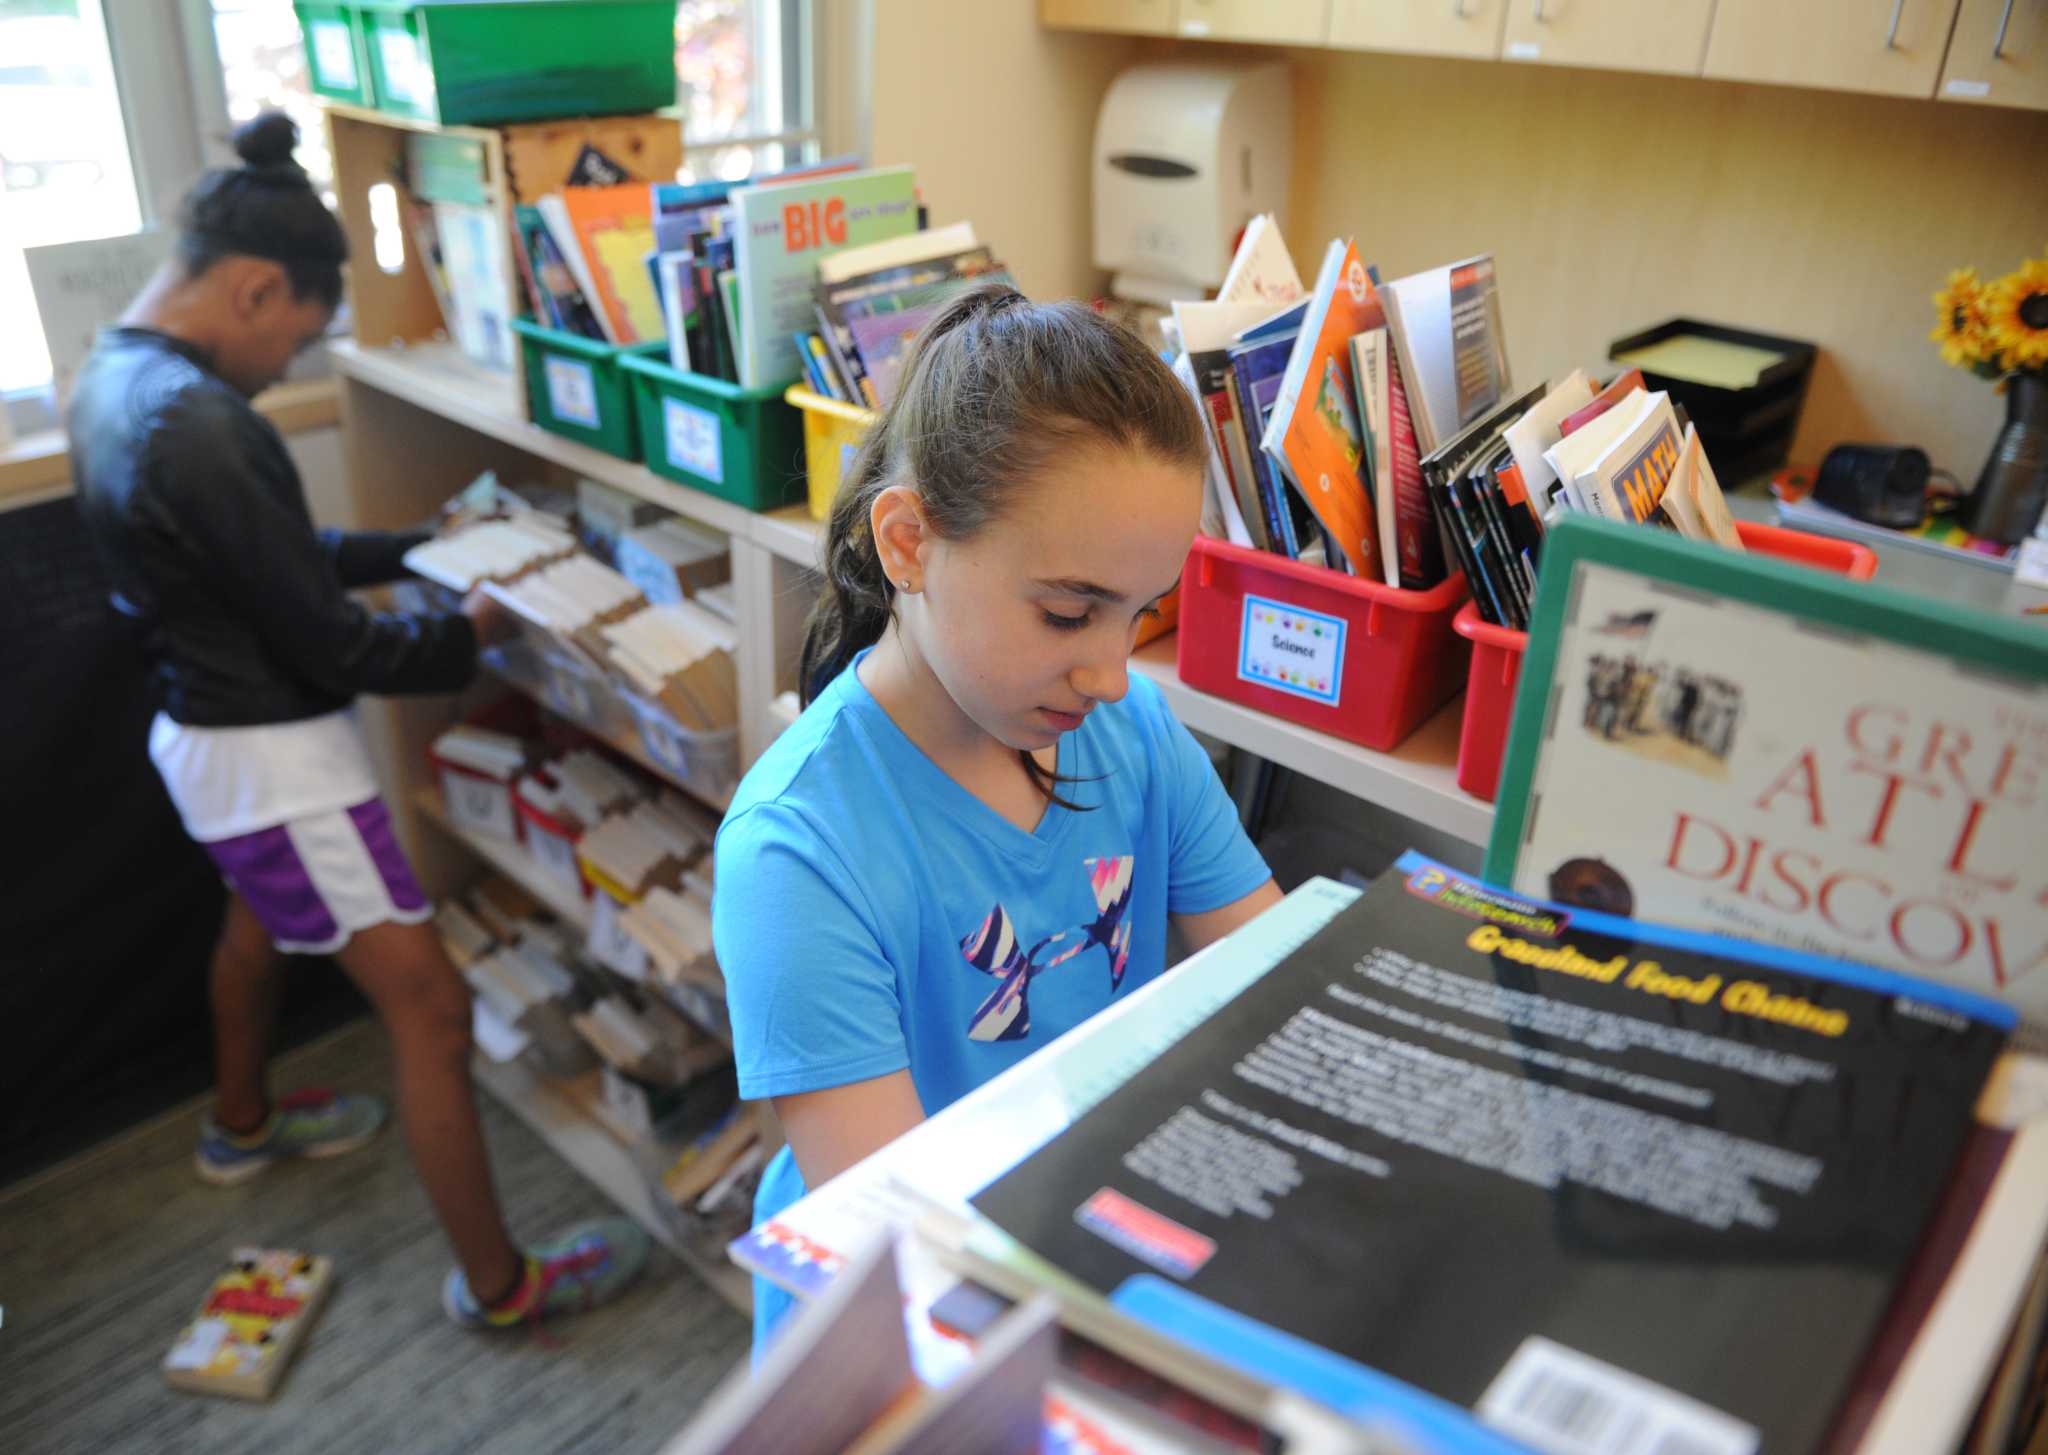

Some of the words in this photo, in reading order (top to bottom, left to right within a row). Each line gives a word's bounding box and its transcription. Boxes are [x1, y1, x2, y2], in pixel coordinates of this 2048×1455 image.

[783, 195, 848, 255] BIG
[1271, 633, 1316, 660] Science
[1753, 744, 2048, 908] ATL
[1625, 960, 1722, 1005] Food
